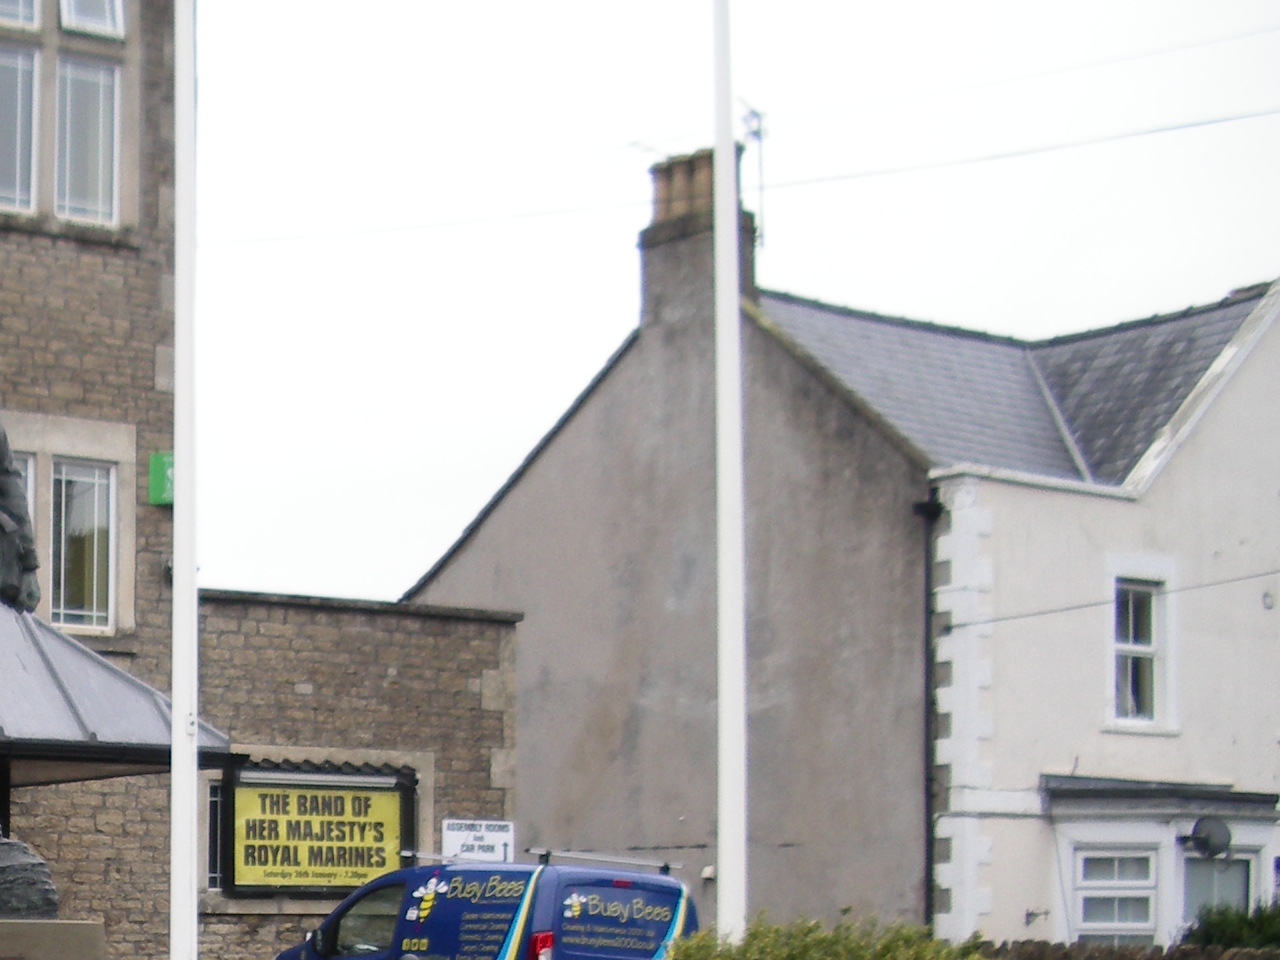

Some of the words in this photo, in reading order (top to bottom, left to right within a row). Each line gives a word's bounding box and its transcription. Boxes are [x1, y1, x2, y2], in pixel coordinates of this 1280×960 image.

[258, 793, 290, 815] THE
[296, 794, 345, 817] BAND
[351, 796, 372, 817] OF
[245, 819, 279, 841] HER
[286, 820, 384, 843] MAJESTY'S
[244, 844, 300, 867] ROYAL
[308, 846, 386, 868] MARINES
[447, 875, 487, 904] Busy
[485, 875, 525, 898] Bees
[587, 894, 630, 923] Busy
[632, 898, 672, 922] Bees
